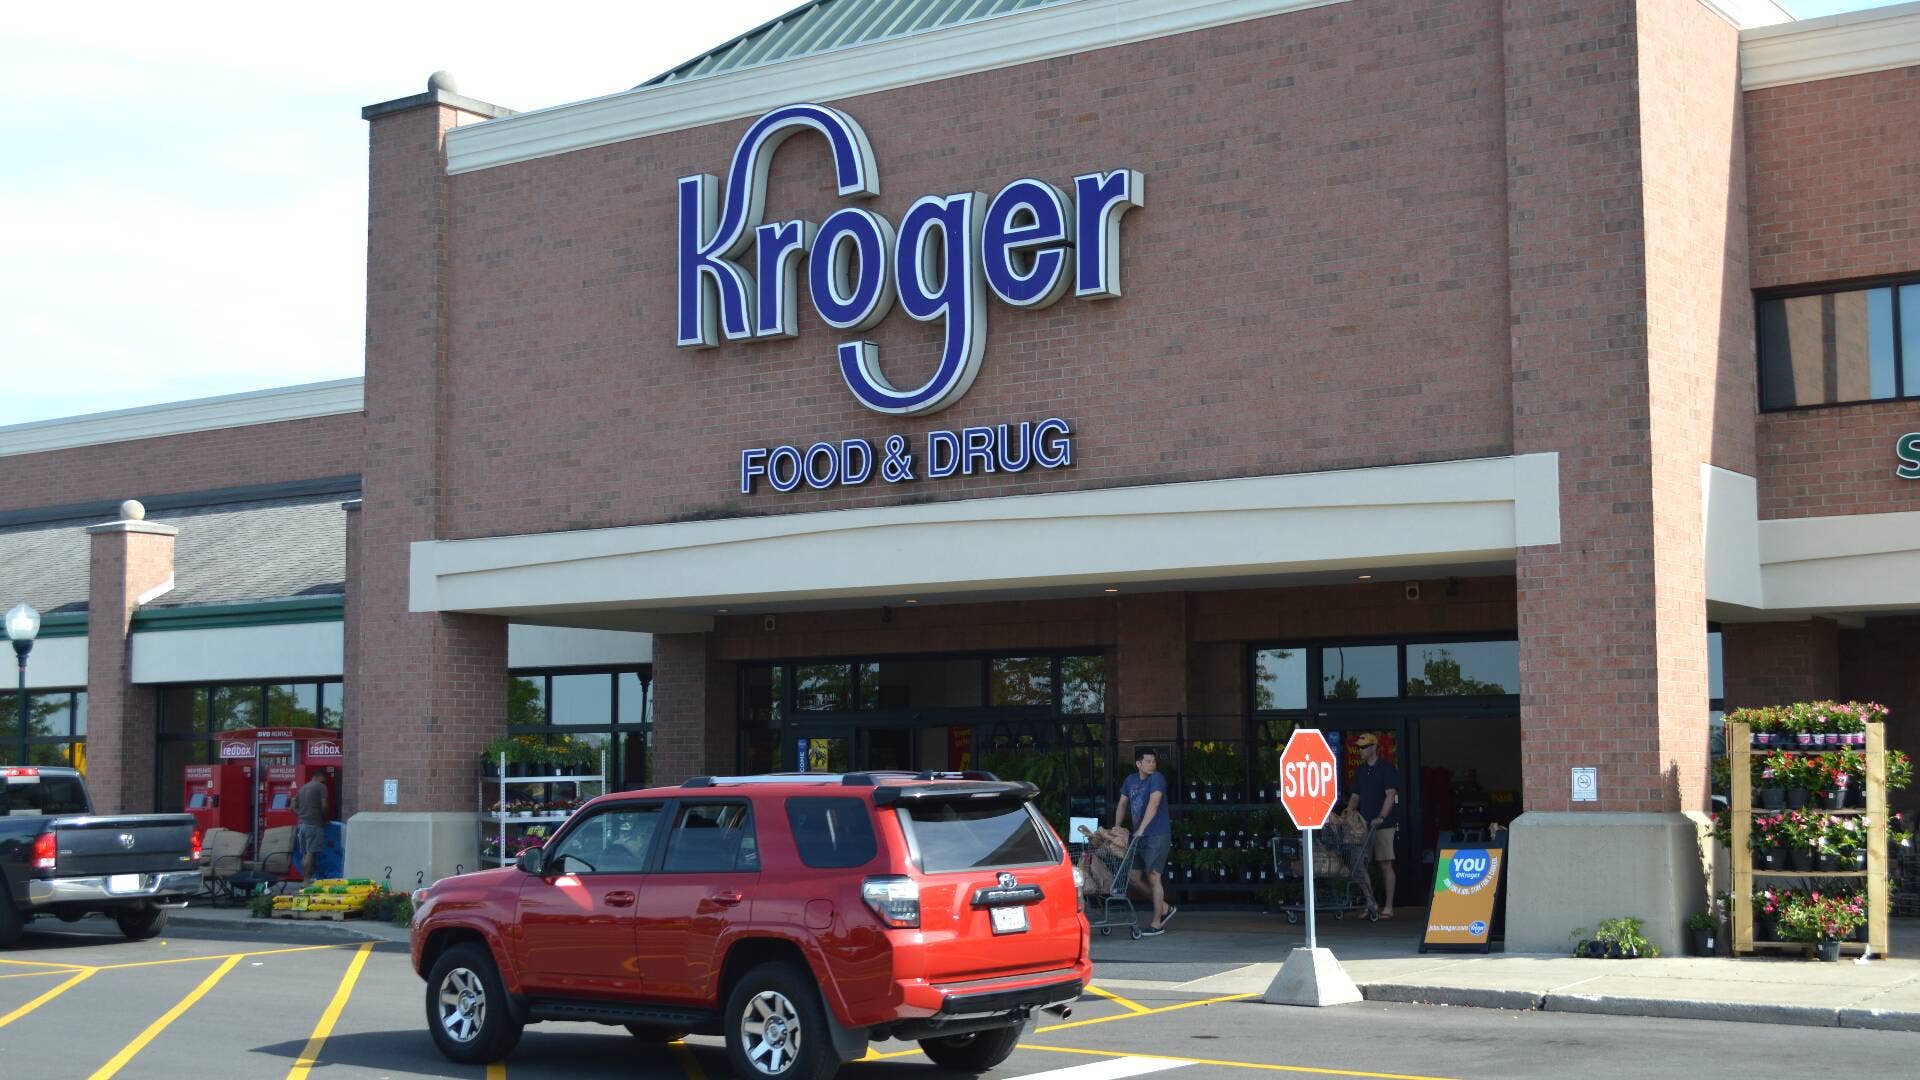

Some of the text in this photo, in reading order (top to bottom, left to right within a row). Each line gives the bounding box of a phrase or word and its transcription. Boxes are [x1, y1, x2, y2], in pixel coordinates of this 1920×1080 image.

[677, 103, 1144, 417] Kroger
[741, 418, 1073, 494] FOOD & DRUG
[223, 744, 251, 756] redbox
[310, 743, 340, 755] redbox
[1285, 761, 1332, 798] STOP
[1453, 858, 1486, 872] YOU
